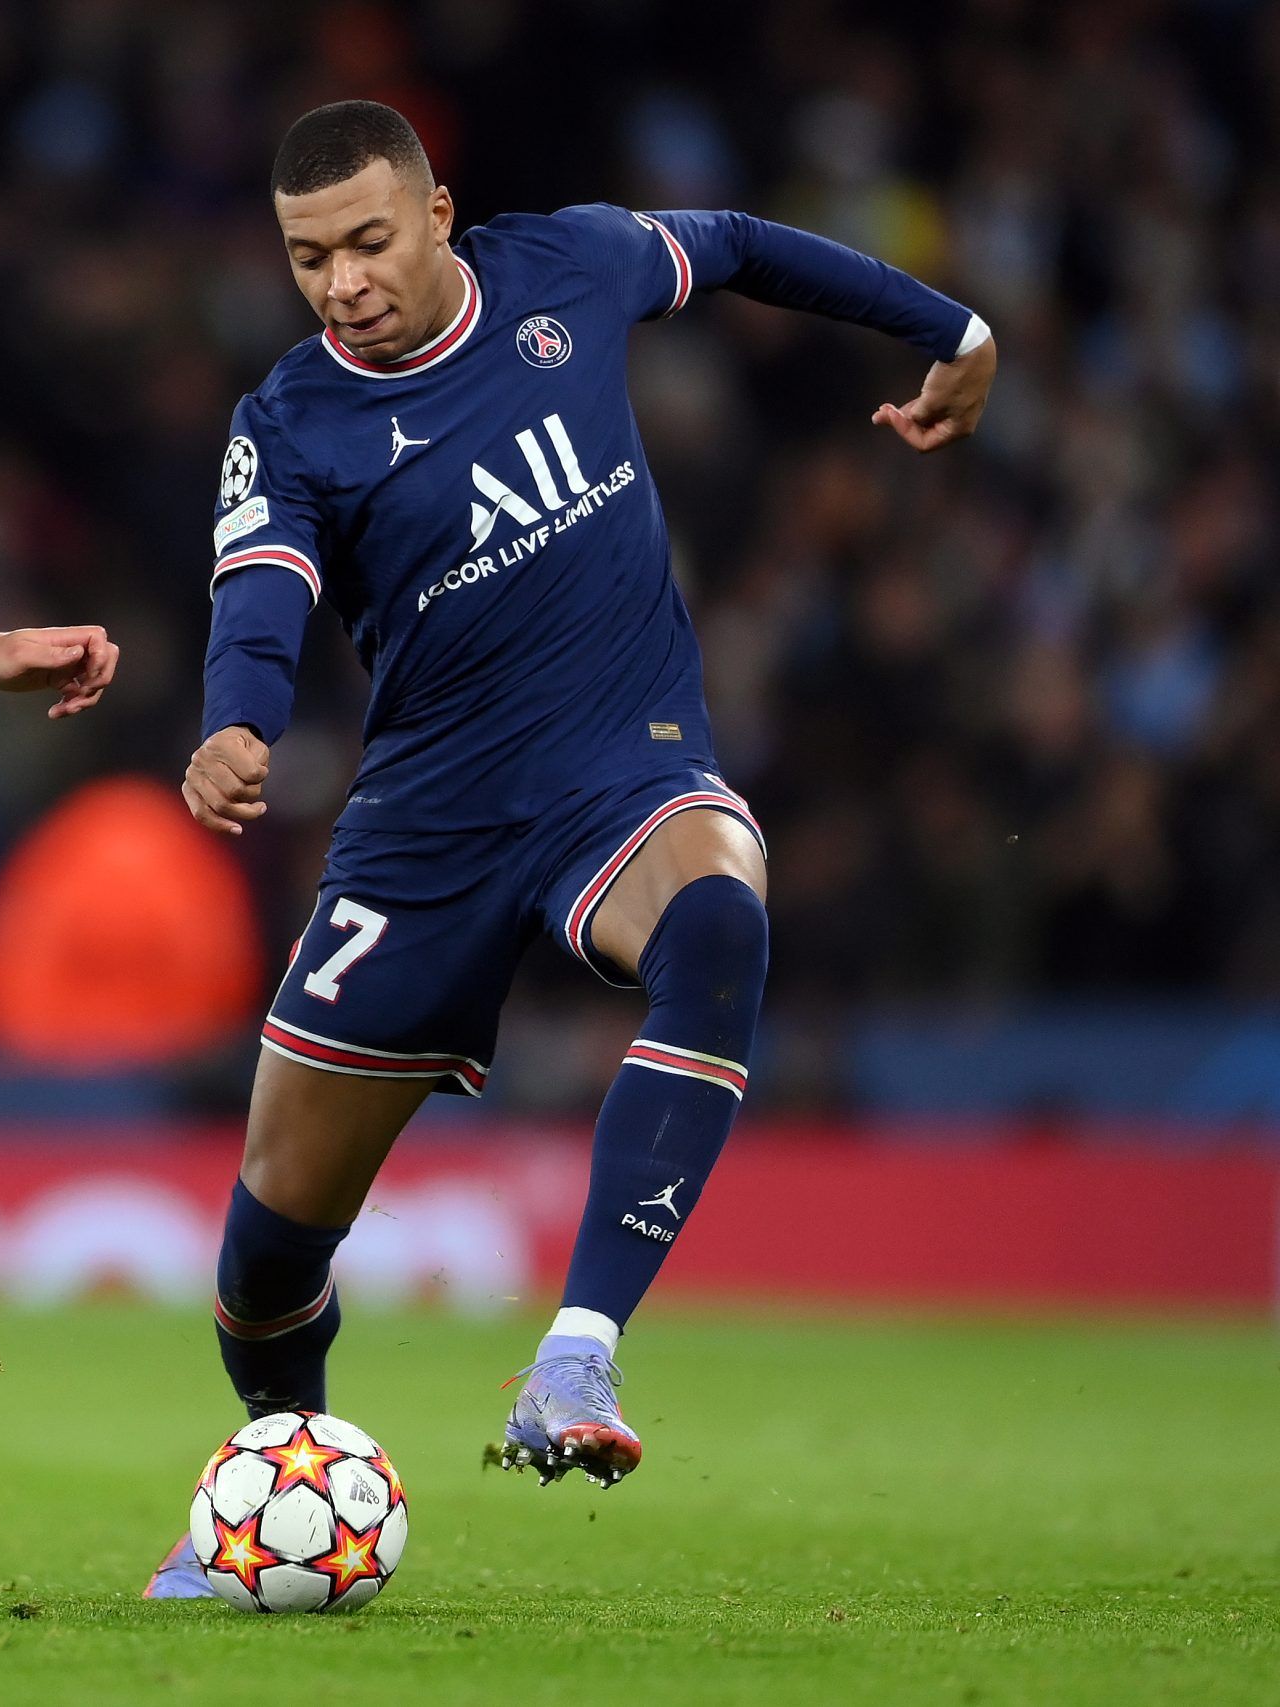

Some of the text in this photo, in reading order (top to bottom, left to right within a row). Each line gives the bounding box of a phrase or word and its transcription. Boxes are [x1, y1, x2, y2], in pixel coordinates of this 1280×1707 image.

[520, 319, 549, 341] PARIS
[418, 556, 499, 612] ACCOR
[554, 461, 636, 534] LIMITLESS
[304, 897, 389, 1005] 7
[621, 1213, 675, 1242] PARIS
